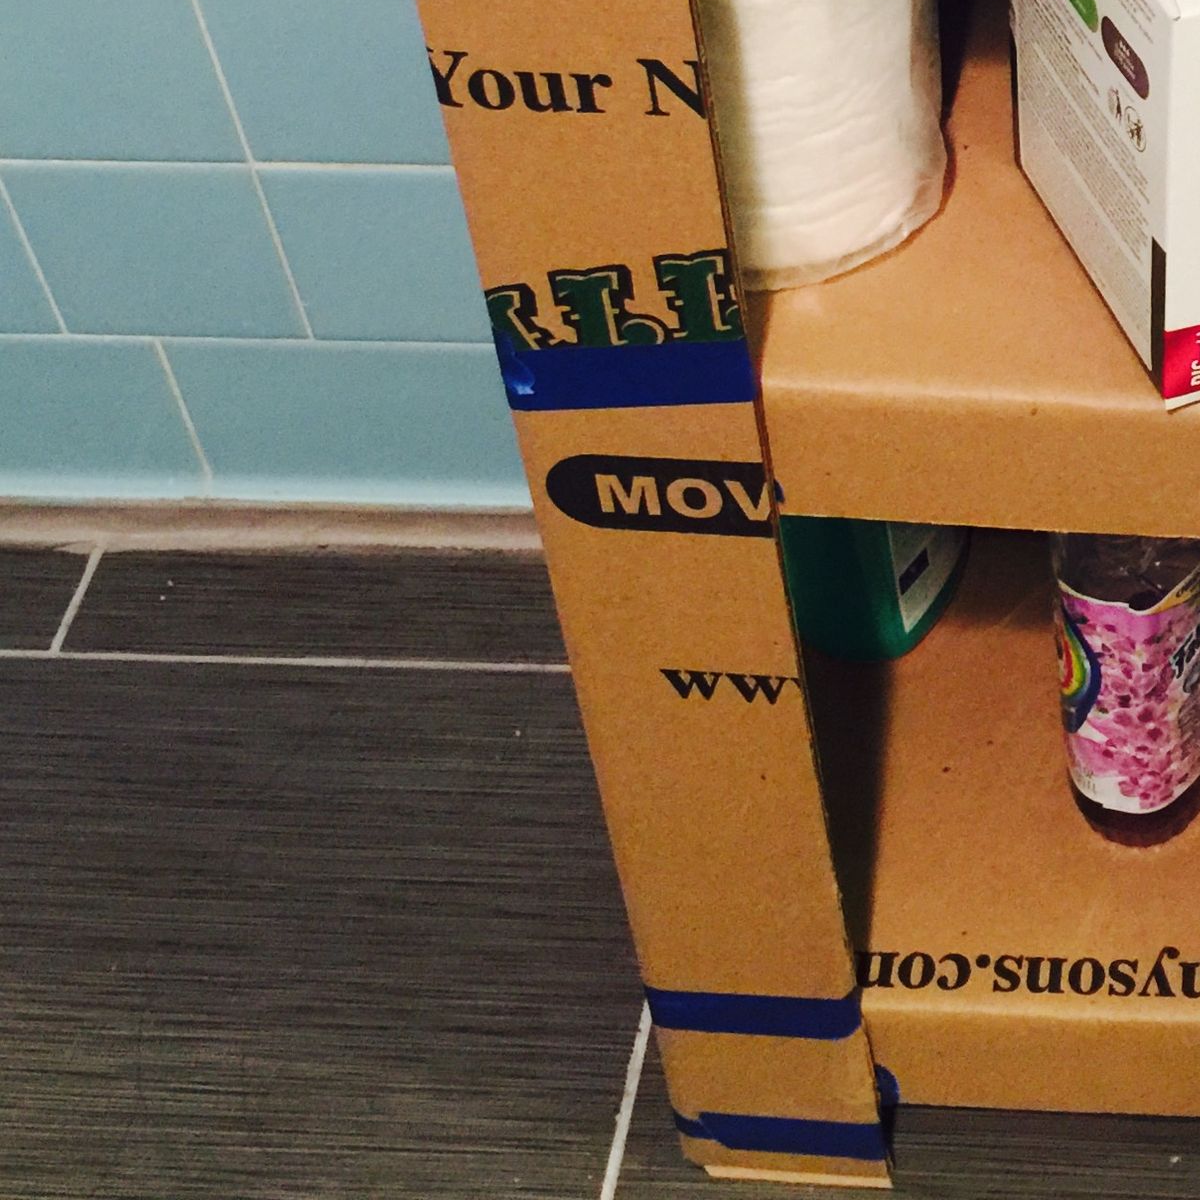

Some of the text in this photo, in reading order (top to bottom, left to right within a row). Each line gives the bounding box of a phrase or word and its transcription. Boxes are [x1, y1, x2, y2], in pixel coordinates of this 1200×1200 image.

[426, 47, 613, 112] Your
[595, 473, 773, 522] MOV
[659, 668, 802, 706] ww
